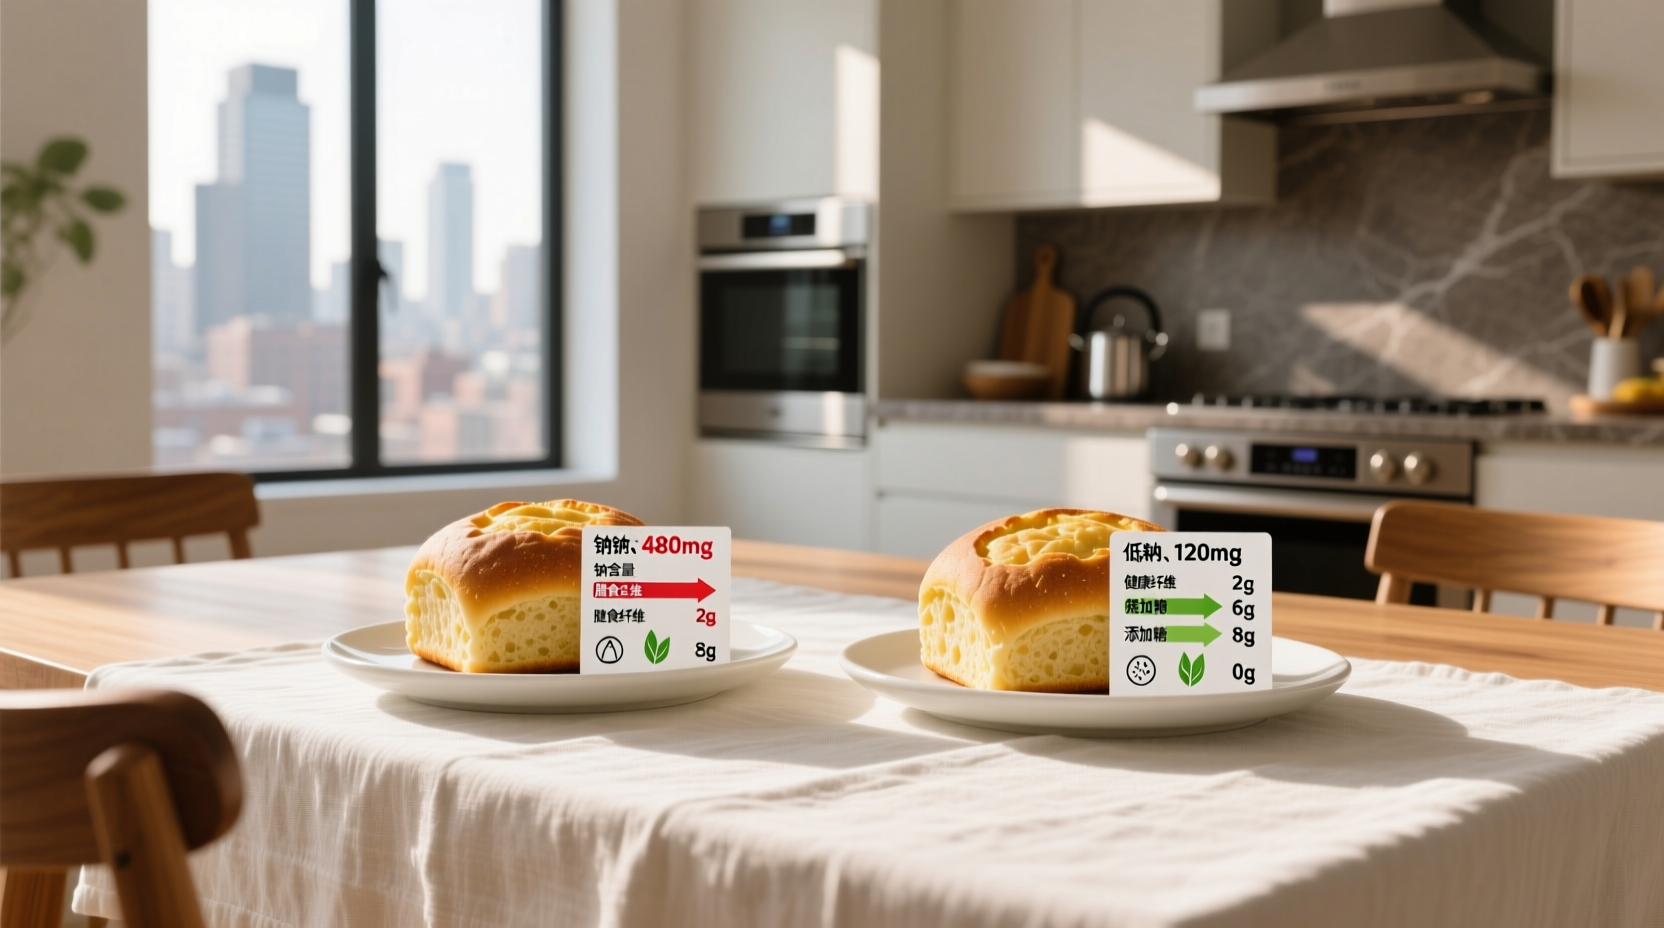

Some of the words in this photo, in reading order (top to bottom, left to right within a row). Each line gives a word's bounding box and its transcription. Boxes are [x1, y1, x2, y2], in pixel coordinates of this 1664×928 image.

[641, 535, 714, 560] 480mg
[1174, 543, 1242, 567] 120mg
[1232, 575, 1255, 595] 2g
[696, 608, 716, 627] 2g
[1232, 599, 1255, 621] 6g
[1232, 627, 1255, 647] 8g
[695, 642, 716, 662] 8g
[1232, 663, 1256, 686] 0g
